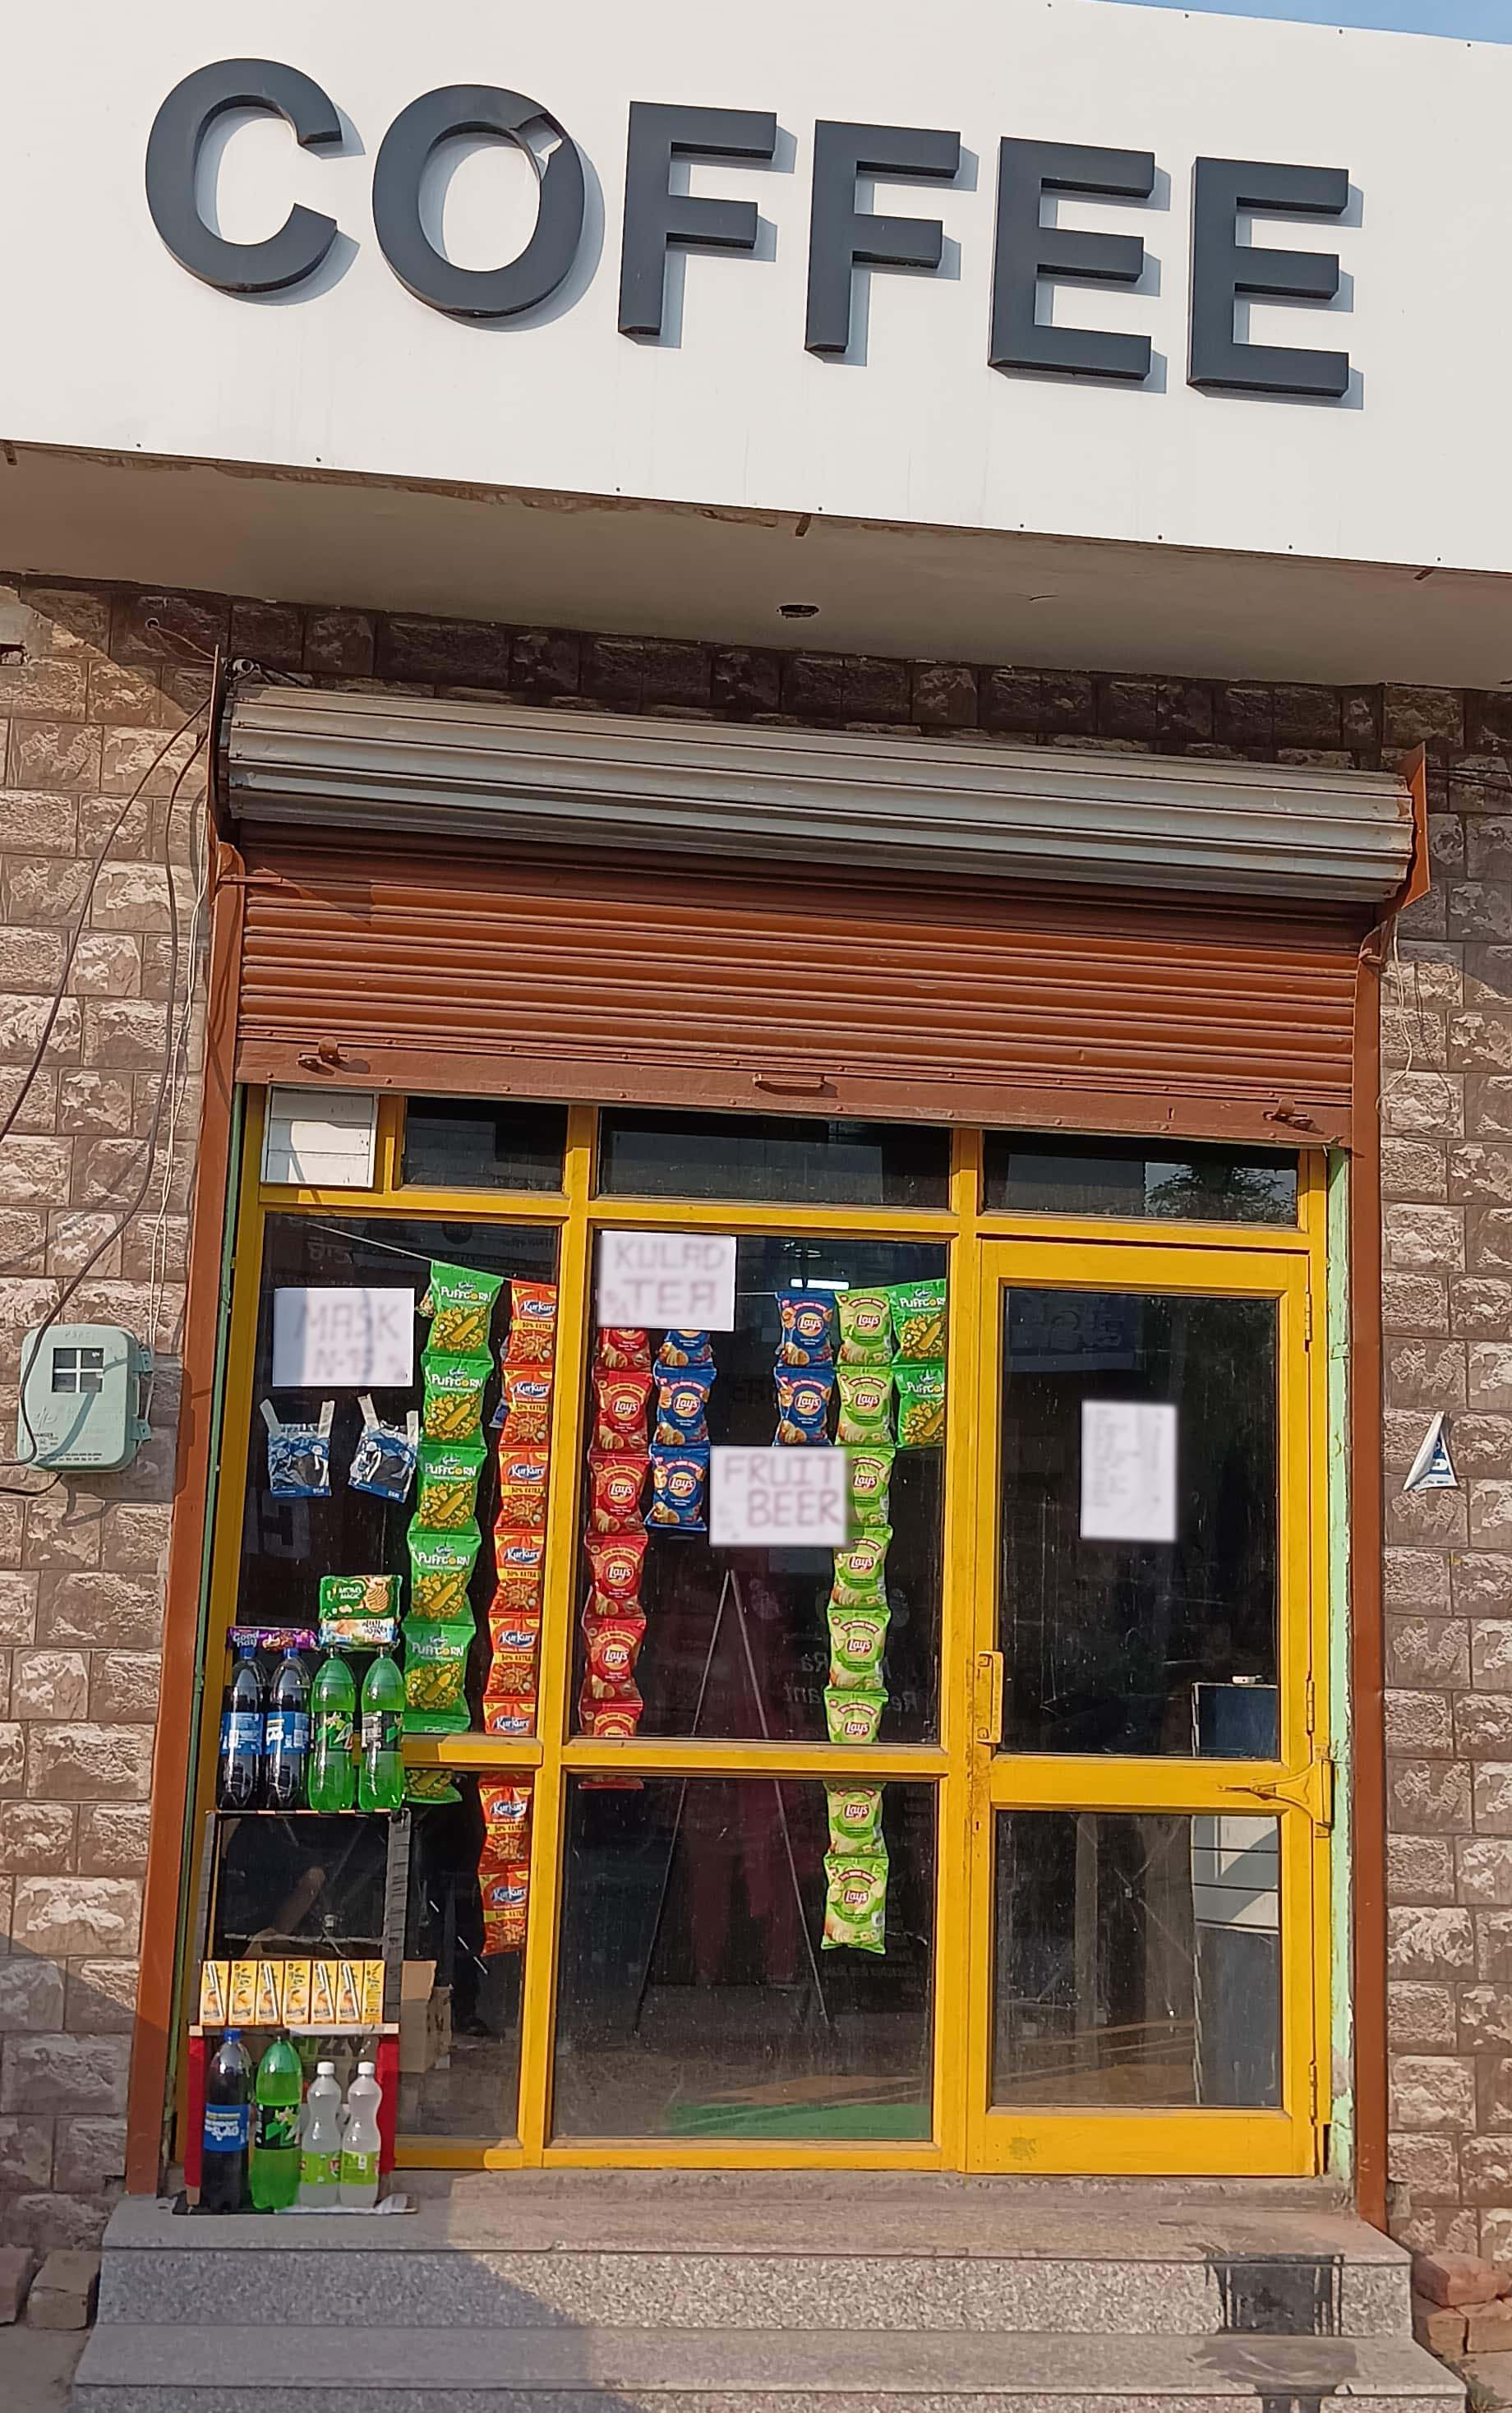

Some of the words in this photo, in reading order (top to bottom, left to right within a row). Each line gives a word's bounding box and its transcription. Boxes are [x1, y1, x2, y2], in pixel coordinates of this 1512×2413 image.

[145, 58, 1349, 396] COFFEE
[724, 1453, 840, 1486] FRUIT
[747, 1488, 844, 1528] BEER
